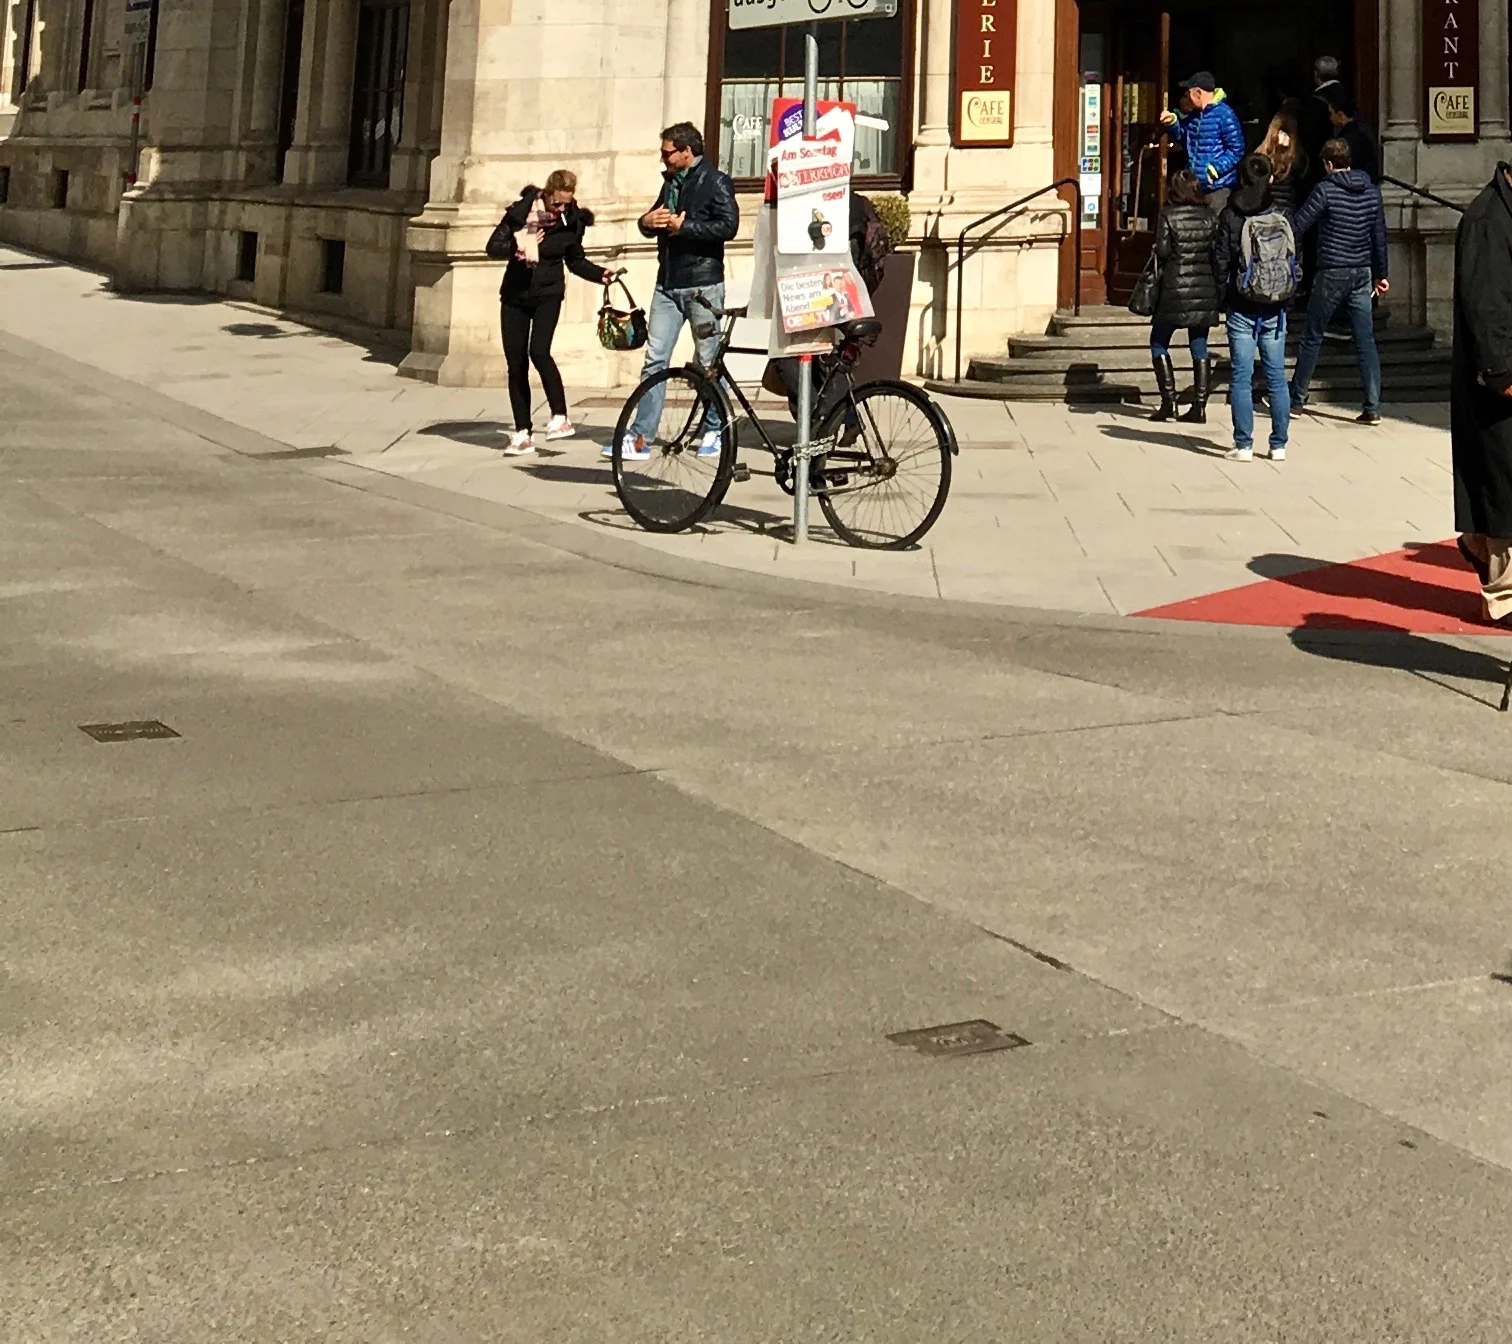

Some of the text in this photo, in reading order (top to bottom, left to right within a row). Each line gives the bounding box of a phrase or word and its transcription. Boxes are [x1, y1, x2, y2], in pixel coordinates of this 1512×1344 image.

[967, 96, 1004, 128] CAFE
[1434, 91, 1470, 123] CAFE
[732, 114, 762, 135] CAFE
[781, 148, 796, 161] Am
[781, 282, 795, 292] Die
[783, 291, 822, 302] News am
[785, 302, 811, 313] Abend
